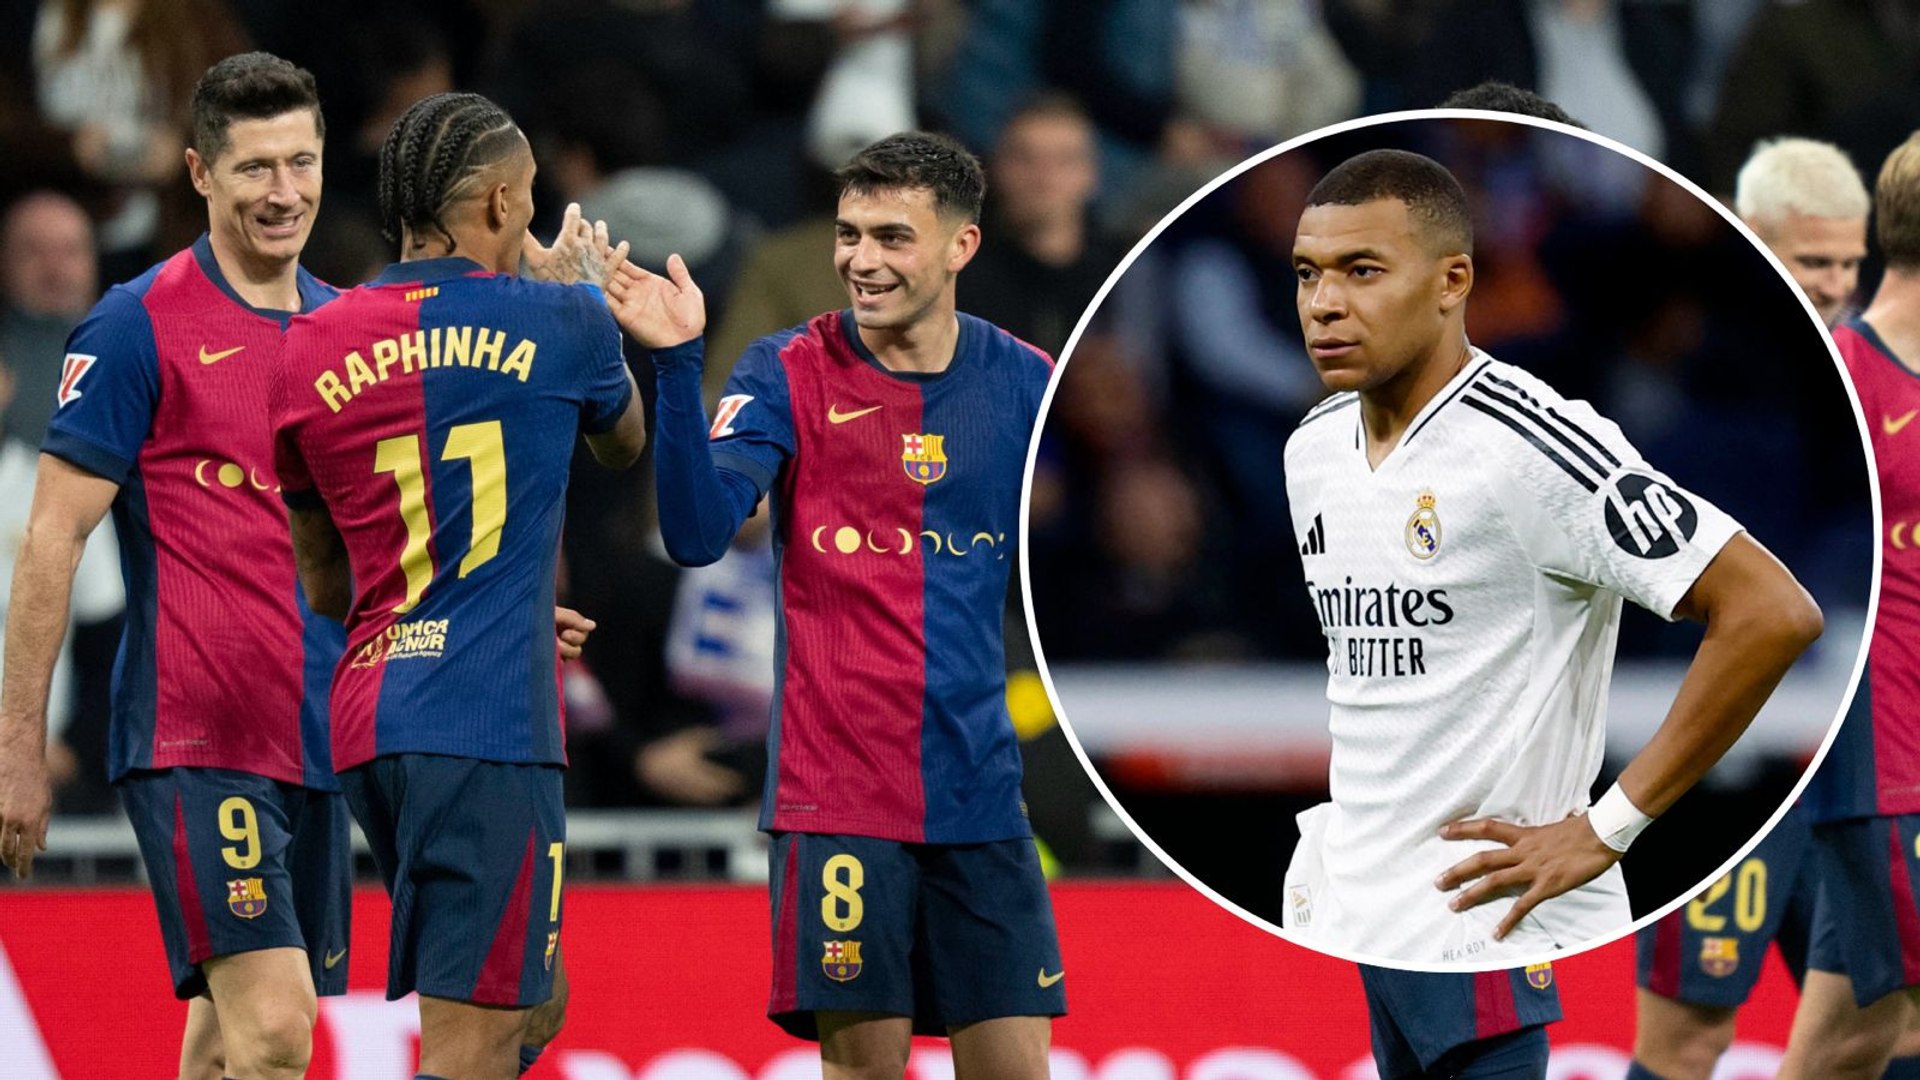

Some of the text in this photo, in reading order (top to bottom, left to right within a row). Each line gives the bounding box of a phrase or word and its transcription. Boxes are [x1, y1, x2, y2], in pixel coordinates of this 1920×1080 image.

[314, 326, 537, 413] RAPHINHA
[373, 420, 508, 614] 11
[1606, 476, 1690, 556] hp
[1305, 576, 1455, 627] mirates
[1347, 637, 1427, 677] BETTER
[218, 796, 262, 869] 9
[548, 842, 563, 922] 1
[821, 854, 864, 932] 8
[1686, 857, 1767, 932] 20
